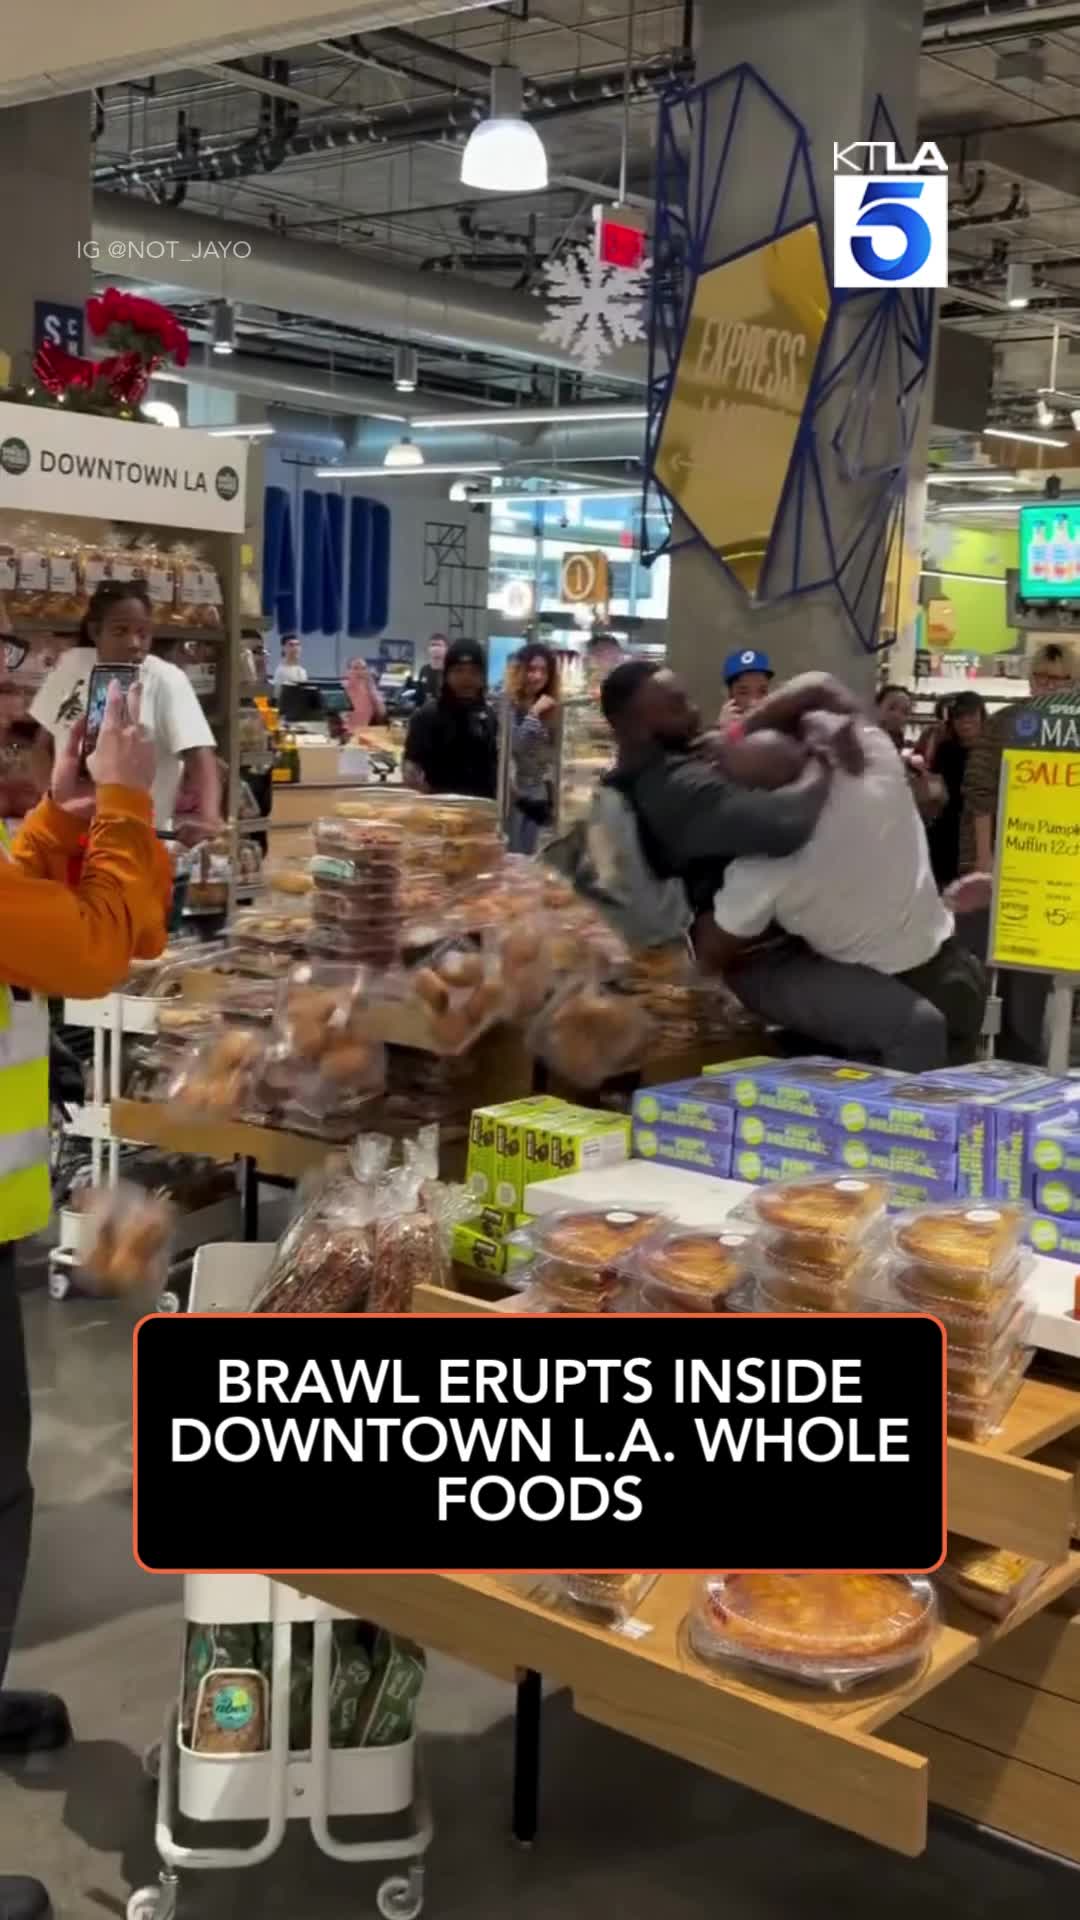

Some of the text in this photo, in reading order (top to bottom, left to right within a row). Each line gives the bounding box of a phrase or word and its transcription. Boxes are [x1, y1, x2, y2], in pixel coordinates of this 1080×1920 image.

[696, 318, 806, 398] EXPRESS
[40, 450, 178, 488] DOWNTOWN
[184, 471, 208, 493] LA
[1015, 760, 1080, 787] SALE
